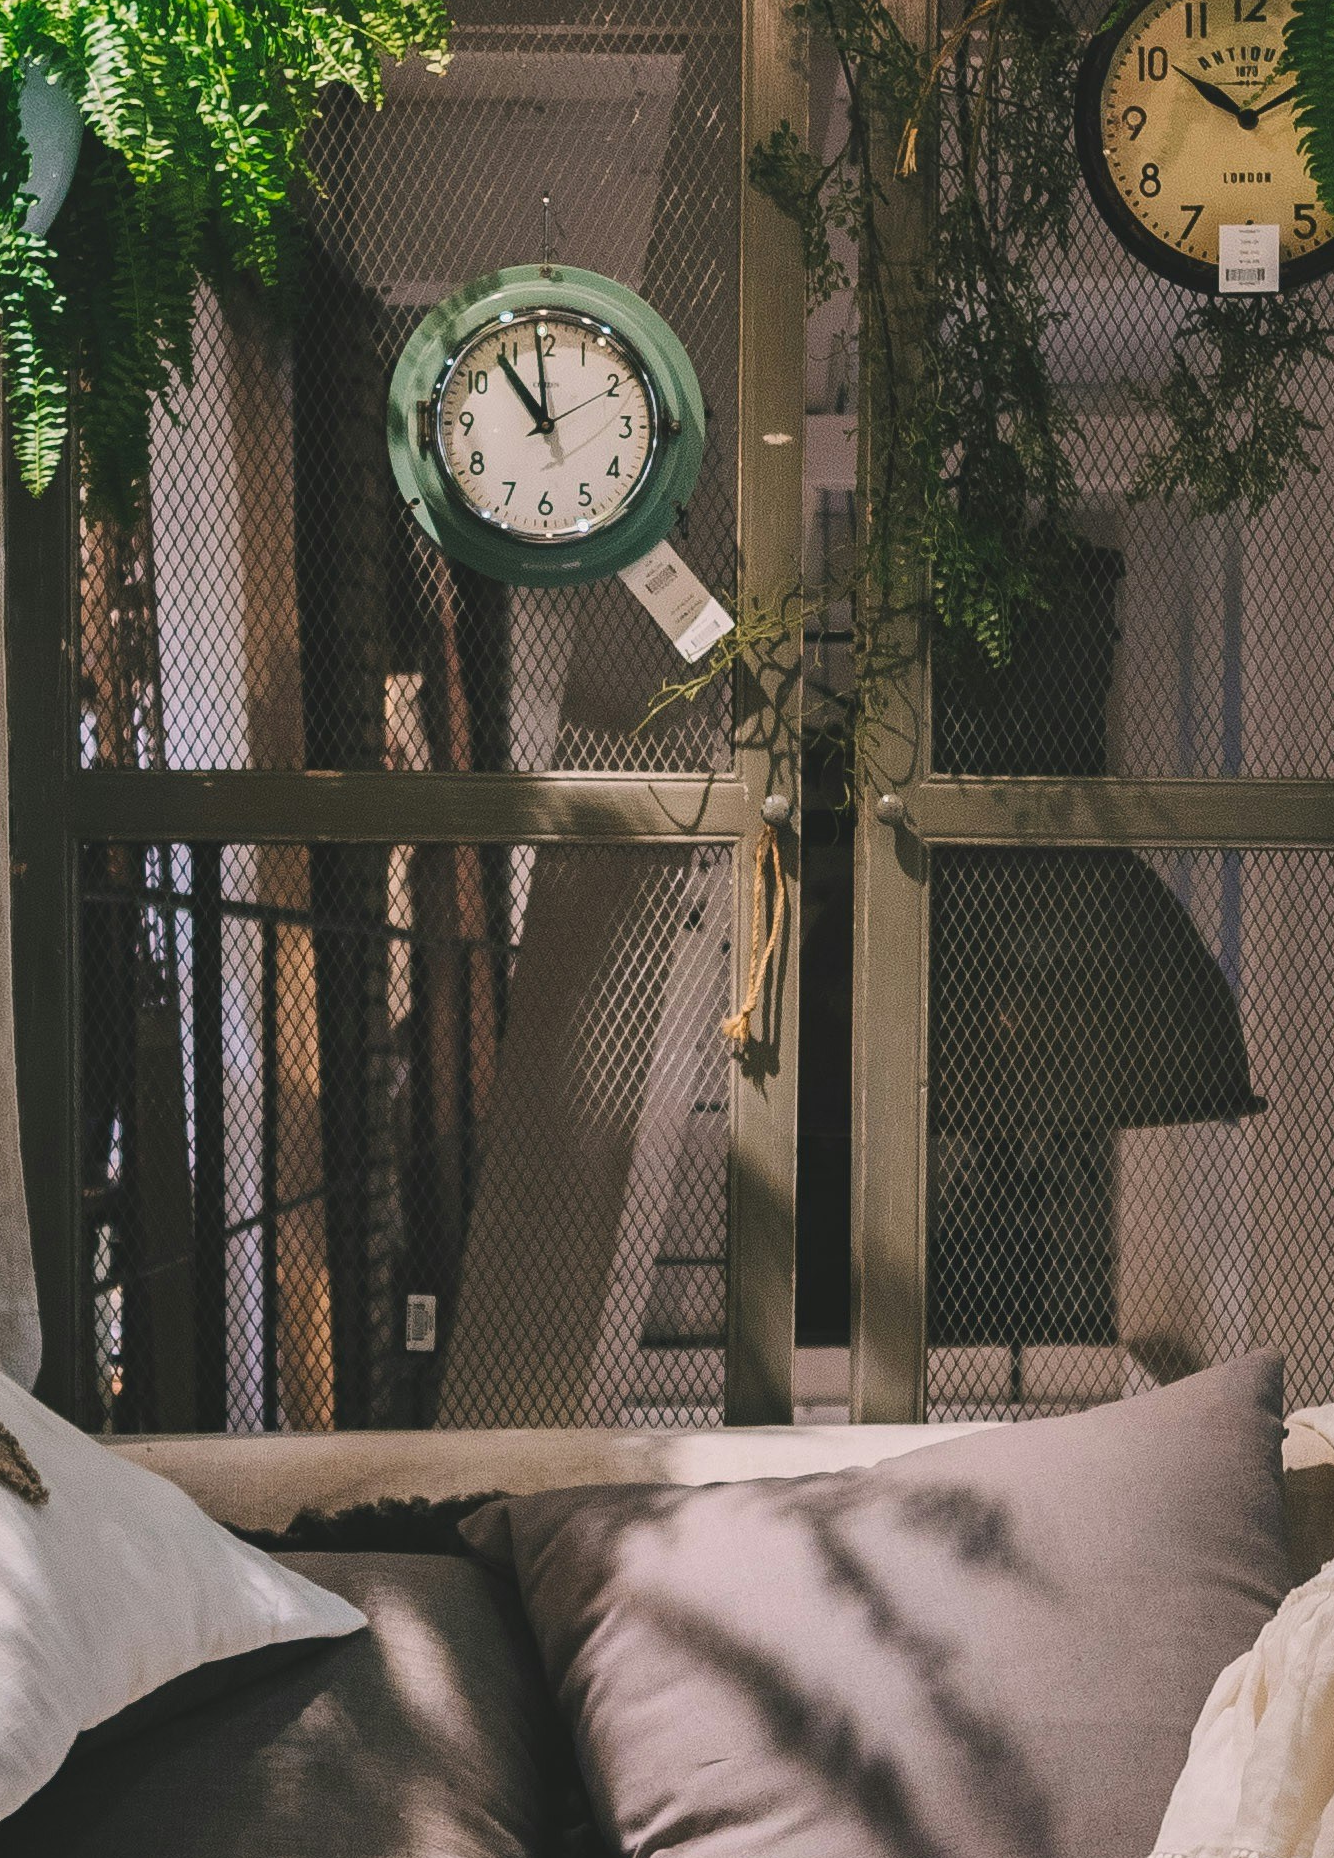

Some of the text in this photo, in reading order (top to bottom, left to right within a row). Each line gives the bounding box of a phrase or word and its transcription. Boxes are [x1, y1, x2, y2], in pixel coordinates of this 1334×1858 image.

[1185, 2, 1207, 39] 11
[1137, 46, 1168, 82] 10
[1197, 46, 1277, 71] ANTIQU
[1122, 106, 1147, 141] 9
[1138, 163, 1162, 198] 8
[1223, 172, 1272, 184] LONDON
[1180, 204, 1205, 240] 7
[1292, 203, 1318, 240] 5
[581, 342, 586, 367] 1
[468, 369, 488, 394] 10
[606, 373, 620, 398] 2
[458, 411, 475, 437] 9
[618, 415, 633, 439] 3
[469, 450, 485, 476] 8
[605, 455, 621, 479] 4
[501, 481, 517, 506] 7
[537, 490, 554, 516] 6
[577, 482, 593, 507] 5
